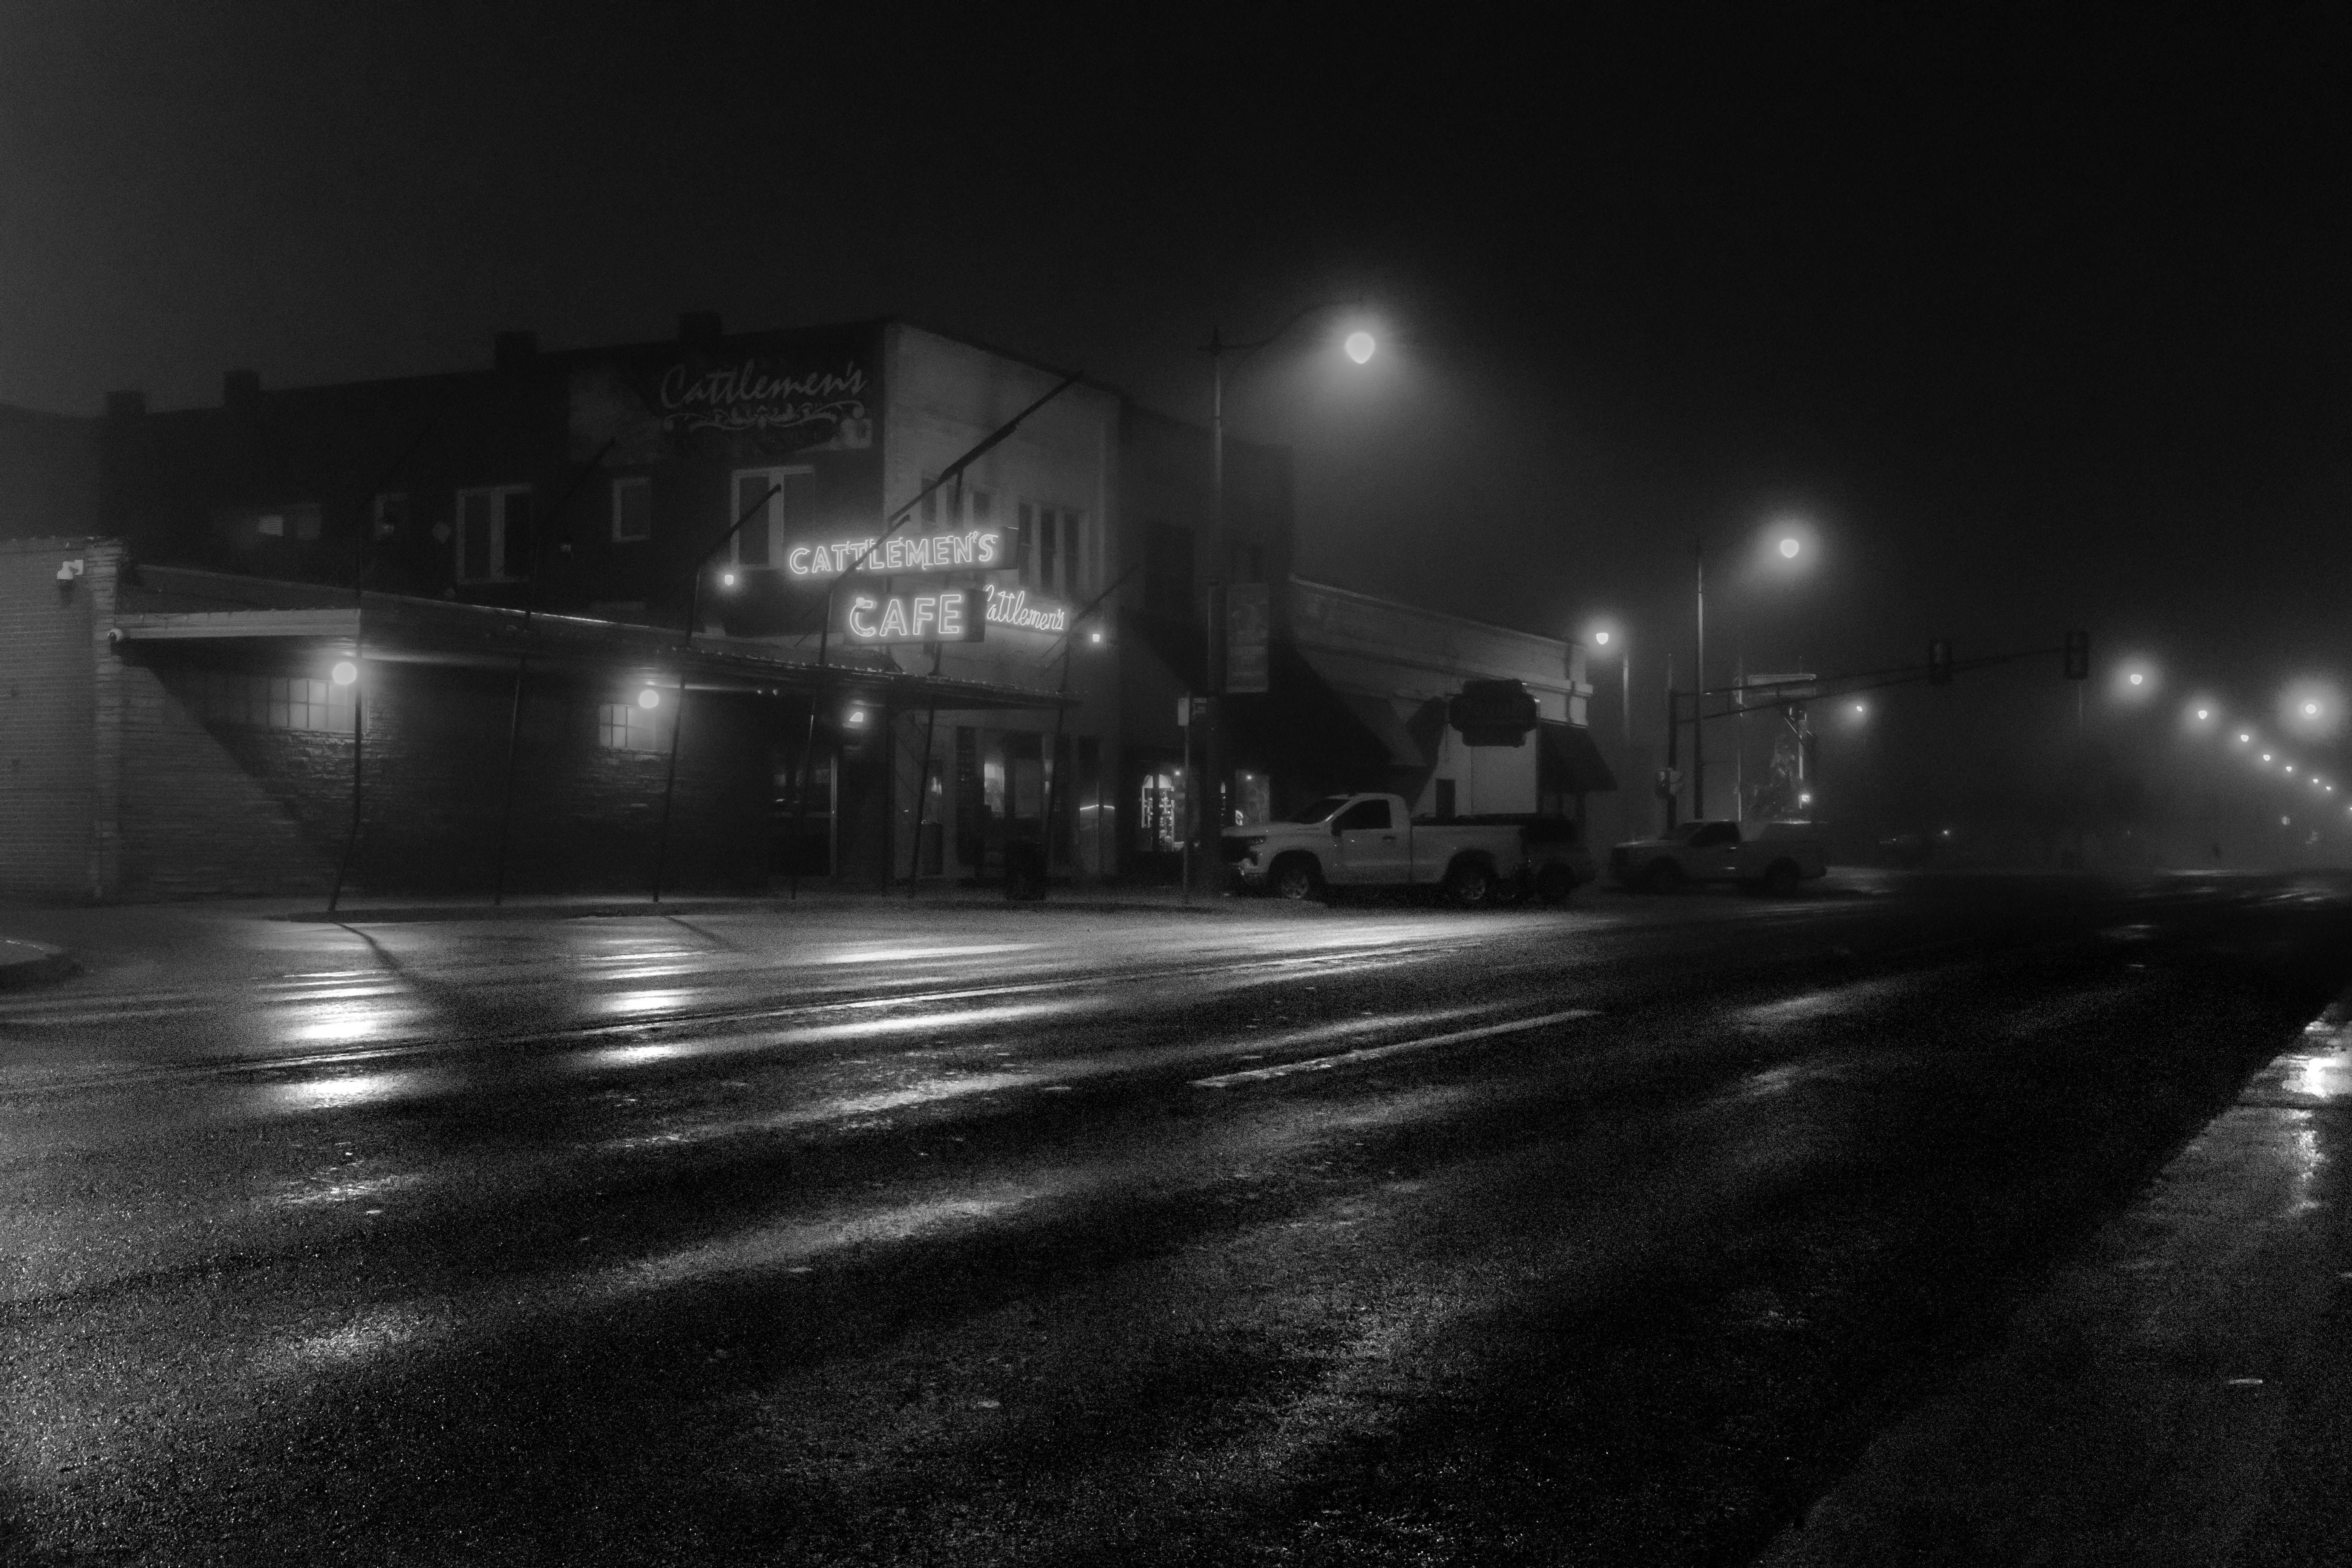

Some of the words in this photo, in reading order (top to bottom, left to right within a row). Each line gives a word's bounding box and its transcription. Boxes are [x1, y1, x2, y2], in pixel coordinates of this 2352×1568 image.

[660, 358, 868, 409] Cattlemen's
[790, 531, 998, 574] CATTLEMEN'S
[850, 594, 961, 637] CAFE
